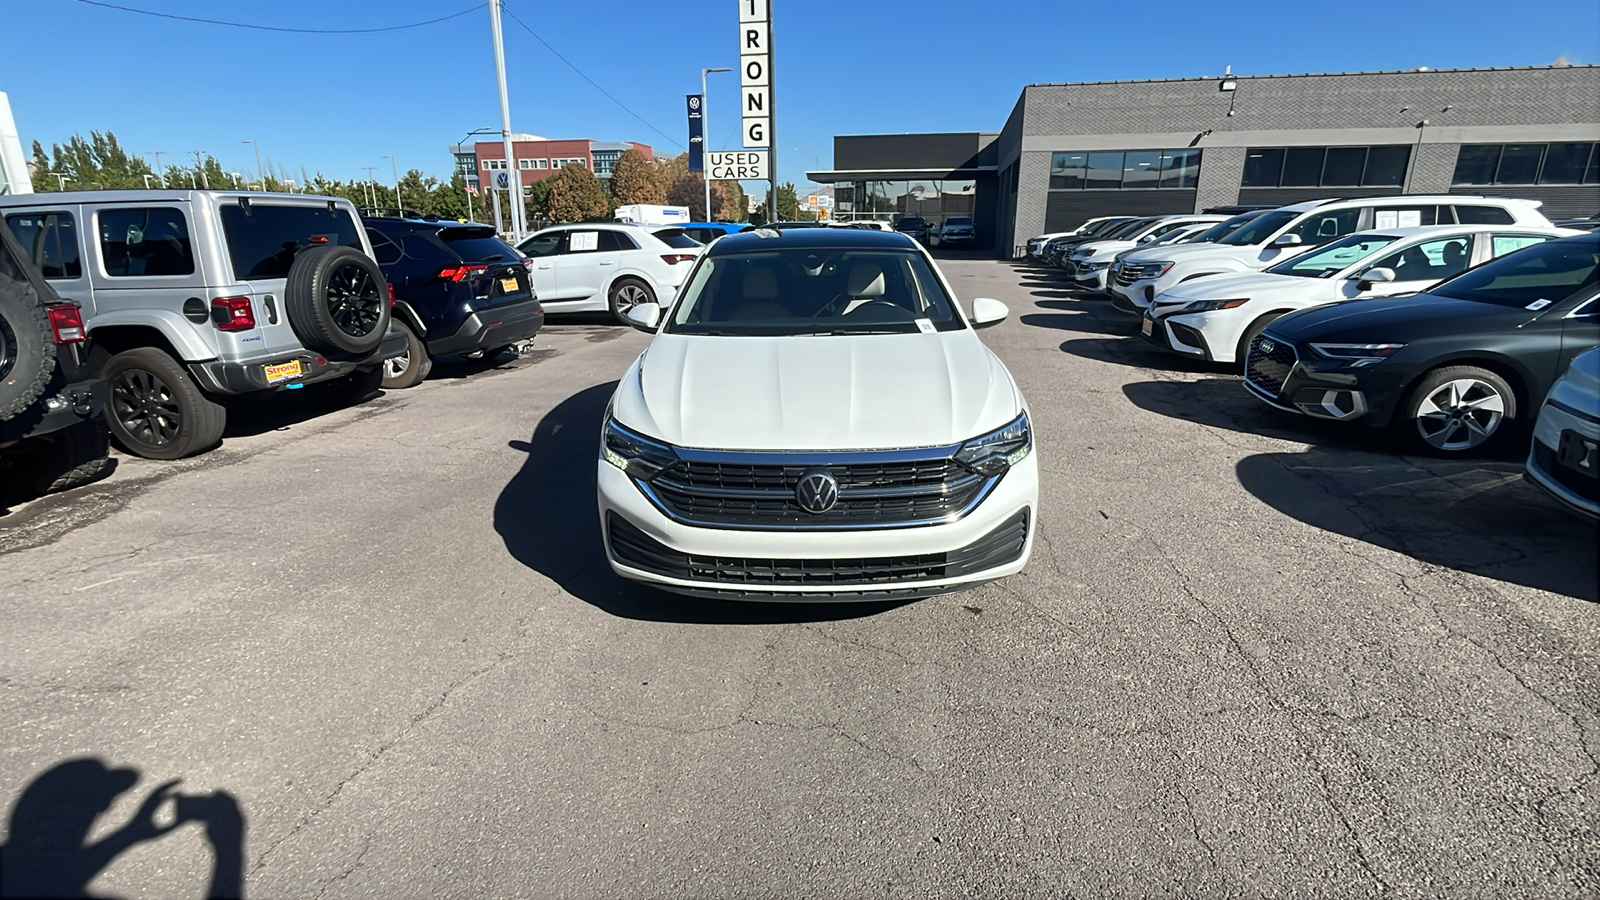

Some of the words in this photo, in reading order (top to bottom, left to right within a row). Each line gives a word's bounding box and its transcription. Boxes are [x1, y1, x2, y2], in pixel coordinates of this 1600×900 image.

[711, 153, 760, 166] USED
[712, 166, 760, 178] CARS
[267, 363, 298, 375] Strong
